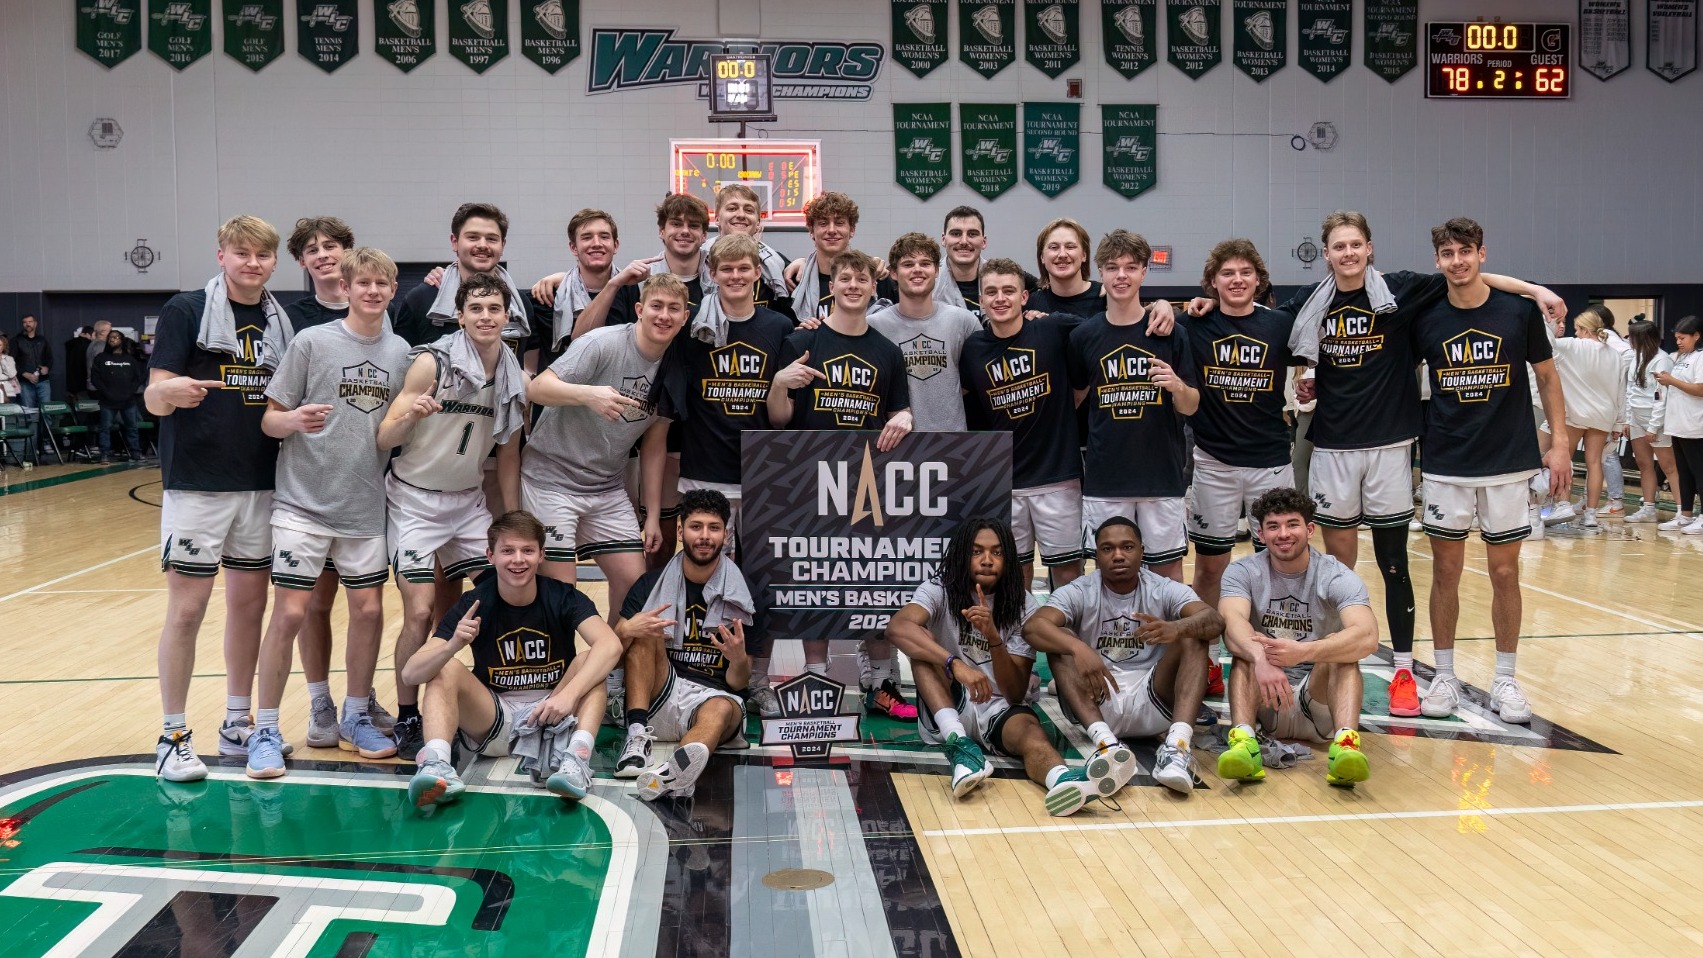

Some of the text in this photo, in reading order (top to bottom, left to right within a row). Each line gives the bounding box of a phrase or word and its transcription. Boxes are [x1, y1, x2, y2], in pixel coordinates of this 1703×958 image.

[378, 38, 432, 46] BASKETBALL
[452, 38, 505, 46] BASKETBALL
[1468, 26, 1517, 49] 00.0
[98, 49, 120, 58] 2017
[170, 54, 191, 62] 2016
[246, 54, 264, 62] 2015
[318, 54, 339, 62] 2014
[396, 55, 416, 64] 2006
[470, 56, 489, 64] 1997
[542, 56, 560, 64] 1996
[1238, 51, 1284, 59] BASKETBALL
[1432, 53, 1564, 65] WARRIORS GUEST
[716, 61, 755, 78] 00.0
[910, 61, 930, 69] 2000
[978, 62, 998, 70] 2003
[1044, 60, 1061, 68] 2011
[1120, 62, 1138, 70] 2012
[1185, 62, 1204, 70] 2012
[1317, 64, 1336, 72] 2014
[1251, 67, 1268, 75] 2013
[1442, 68, 1470, 91] 78
[1536, 68, 1564, 92] 62
[774, 84, 870, 98] CHAMPIONS
[896, 121, 949, 129] TOURNAMENT
[1326, 314, 1368, 338] NACC
[1220, 340, 1260, 366] NACC
[1452, 337, 1494, 364] NACC
[718, 349, 760, 376] NACC
[905, 356, 947, 368] HAMPIONS
[1108, 352, 1148, 379] NACC
[832, 361, 871, 387] NACC
[992, 356, 1031, 382] NACC
[226, 375, 271, 386] TOURNAME
[342, 378, 390, 388] BASKETBALL
[1010, 378, 1042, 391] BASKETBALL
[1208, 374, 1268, 387] TOURNAMENT
[1442, 373, 1505, 387] TOURNAMENT
[339, 384, 390, 400] CHAMPIONS
[707, 387, 768, 398] TOURNAMENT
[992, 383, 1045, 406] TOURNAMENT
[1101, 391, 1156, 404] TOURNAMENT
[438, 399, 494, 417] WARRIOR
[820, 397, 875, 412] TOURNAMENT
[1004, 397, 1036, 408] CHAMPIONS
[456, 420, 474, 455] 1
[818, 439, 948, 527] NACC
[768, 536, 950, 558] TOURNAME
[792, 561, 940, 582] CHAMPION
[776, 590, 913, 606] MEN'S BASKE
[848, 614, 891, 630] 202
[1262, 614, 1313, 633] CHAMPIONS
[504, 635, 546, 663] NACC
[494, 670, 560, 686] TOURNAMENT
[788, 684, 834, 714] NACC
[778, 724, 842, 734] TOURNAMENT
[781, 732, 836, 740] CHAMPIONS
